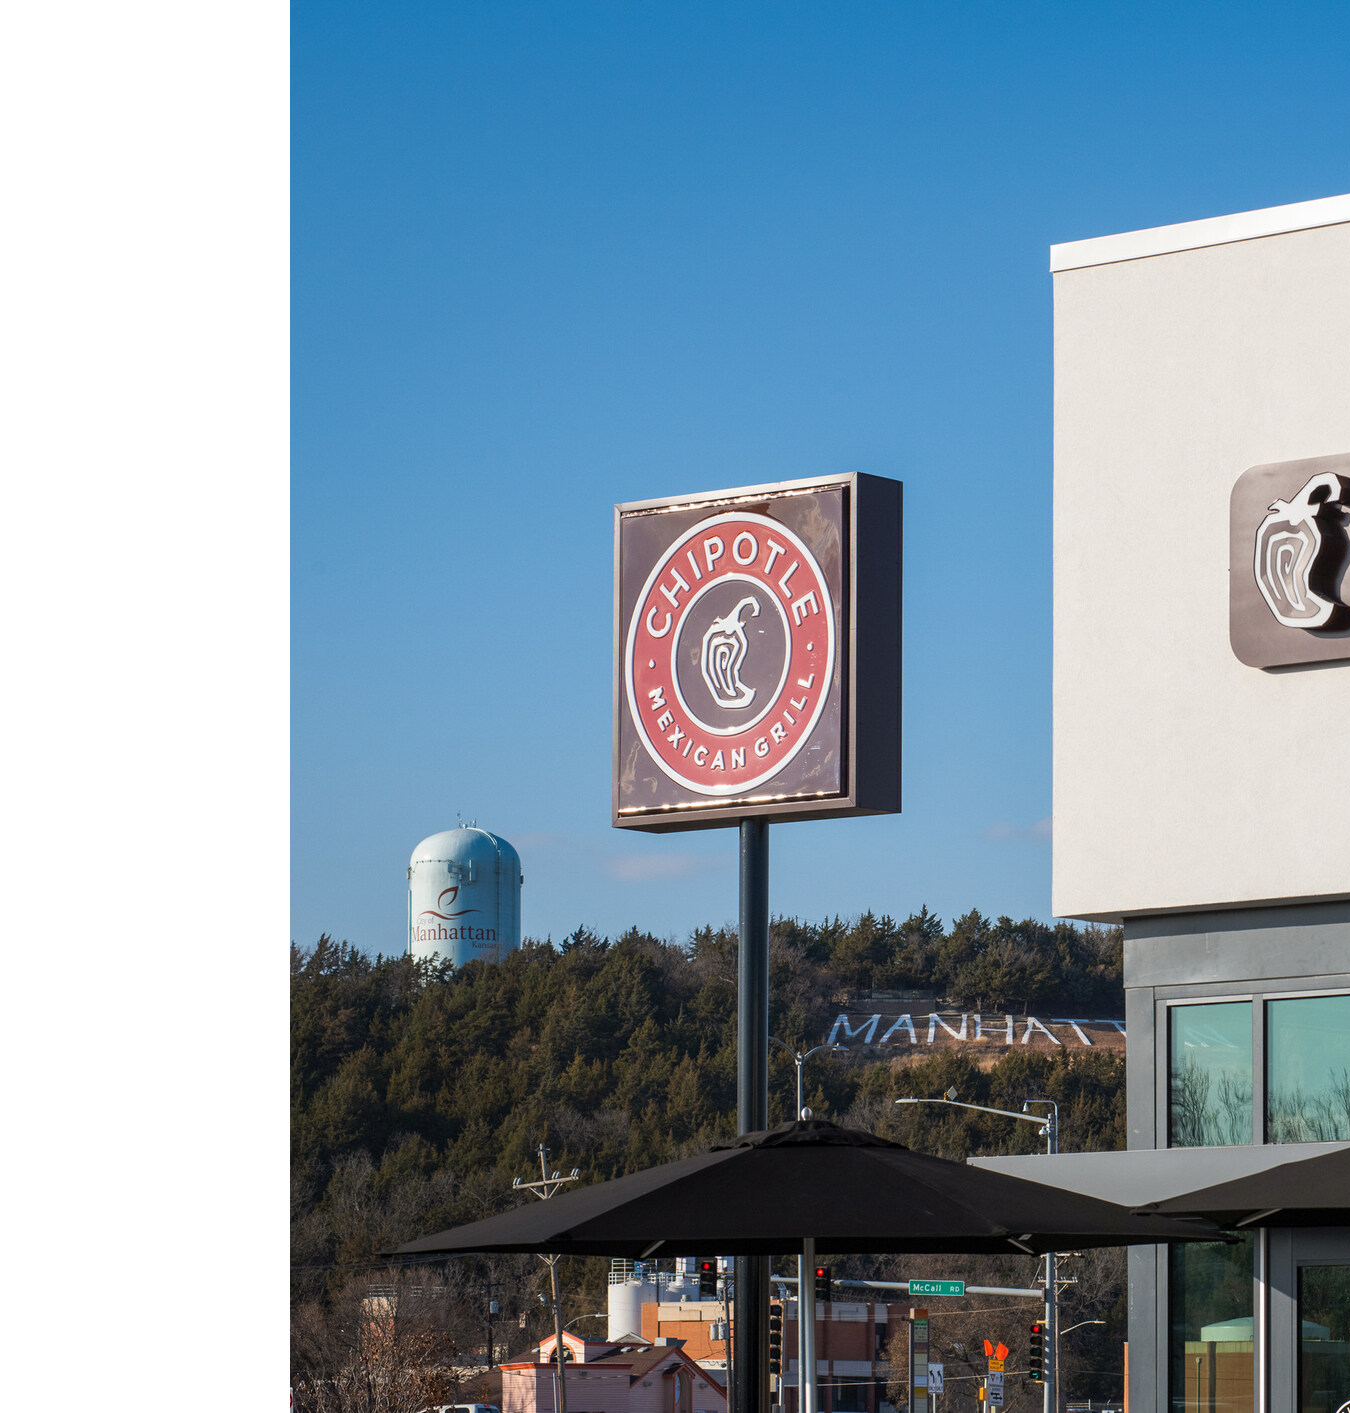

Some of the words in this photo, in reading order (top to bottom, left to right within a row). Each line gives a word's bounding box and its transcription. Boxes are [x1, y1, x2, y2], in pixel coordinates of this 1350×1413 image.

[646, 530, 820, 638] CHIPOTLE
[648, 685, 746, 771] MEXICAN
[754, 672, 815, 758] GRILL
[411, 923, 497, 942] Manhattan
[913, 1283, 942, 1292] McCall
[949, 1285, 960, 1293] RD
